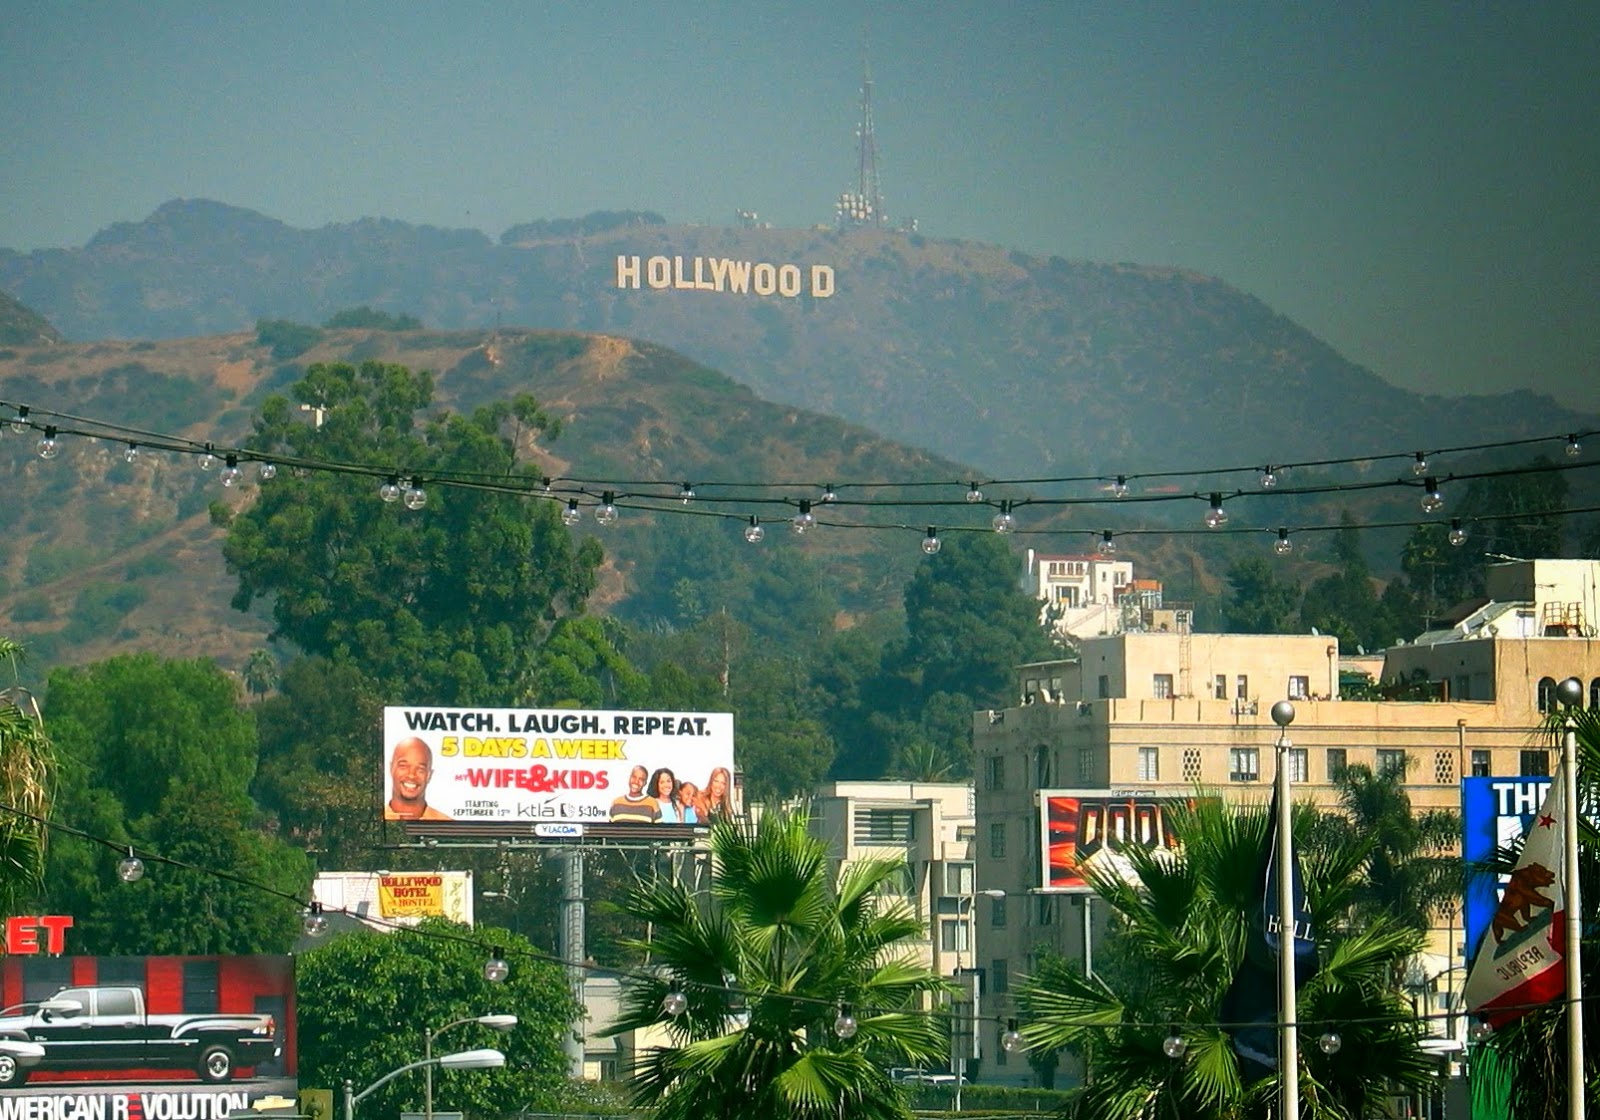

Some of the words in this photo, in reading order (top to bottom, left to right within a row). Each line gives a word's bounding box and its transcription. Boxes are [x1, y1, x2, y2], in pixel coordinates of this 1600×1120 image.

[617, 255, 835, 298] HOLLYWOOD
[404, 711, 501, 732] WATCH.
[508, 714, 606, 734] LAUGH.
[614, 716, 711, 736] REPEAT.
[441, 736, 459, 757] 5
[464, 737, 528, 758] DAYS
[531, 738, 552, 758] A
[552, 739, 628, 760] WEEK
[465, 800, 499, 808] STARTING
[453, 808, 494, 817] SEPTEMBER
[542, 825, 577, 835] VIACOM
[381, 876, 442, 887] HOLLYWOOD
[394, 888, 430, 898] HOTEL
[399, 899, 435, 907] HOSTEL
[0, 1094, 106, 1120] MERICAN
